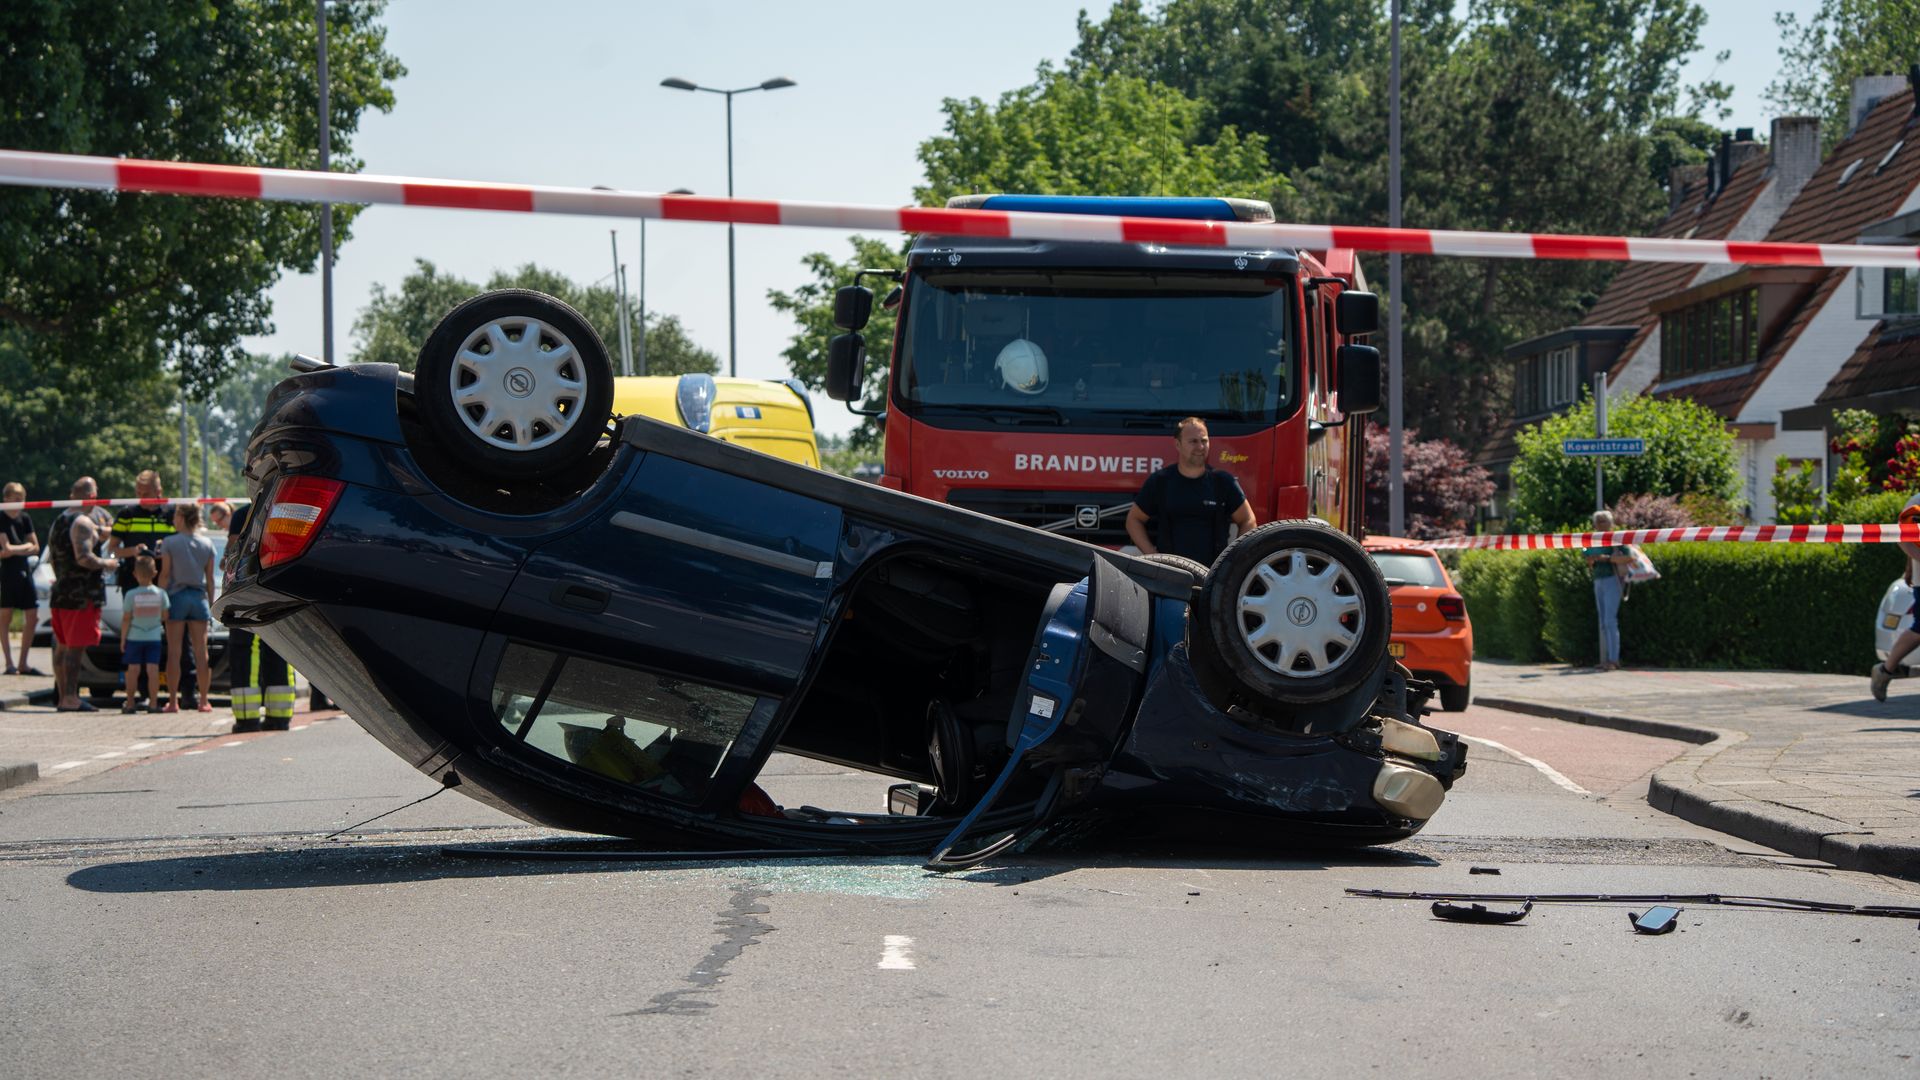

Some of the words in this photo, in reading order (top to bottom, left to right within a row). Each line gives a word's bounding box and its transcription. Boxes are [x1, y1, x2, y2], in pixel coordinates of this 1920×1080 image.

[1567, 442, 1641, 452] Koweitstraat
[1015, 454, 1164, 473] BRANDWEER
[932, 469, 990, 479] VOLVO
